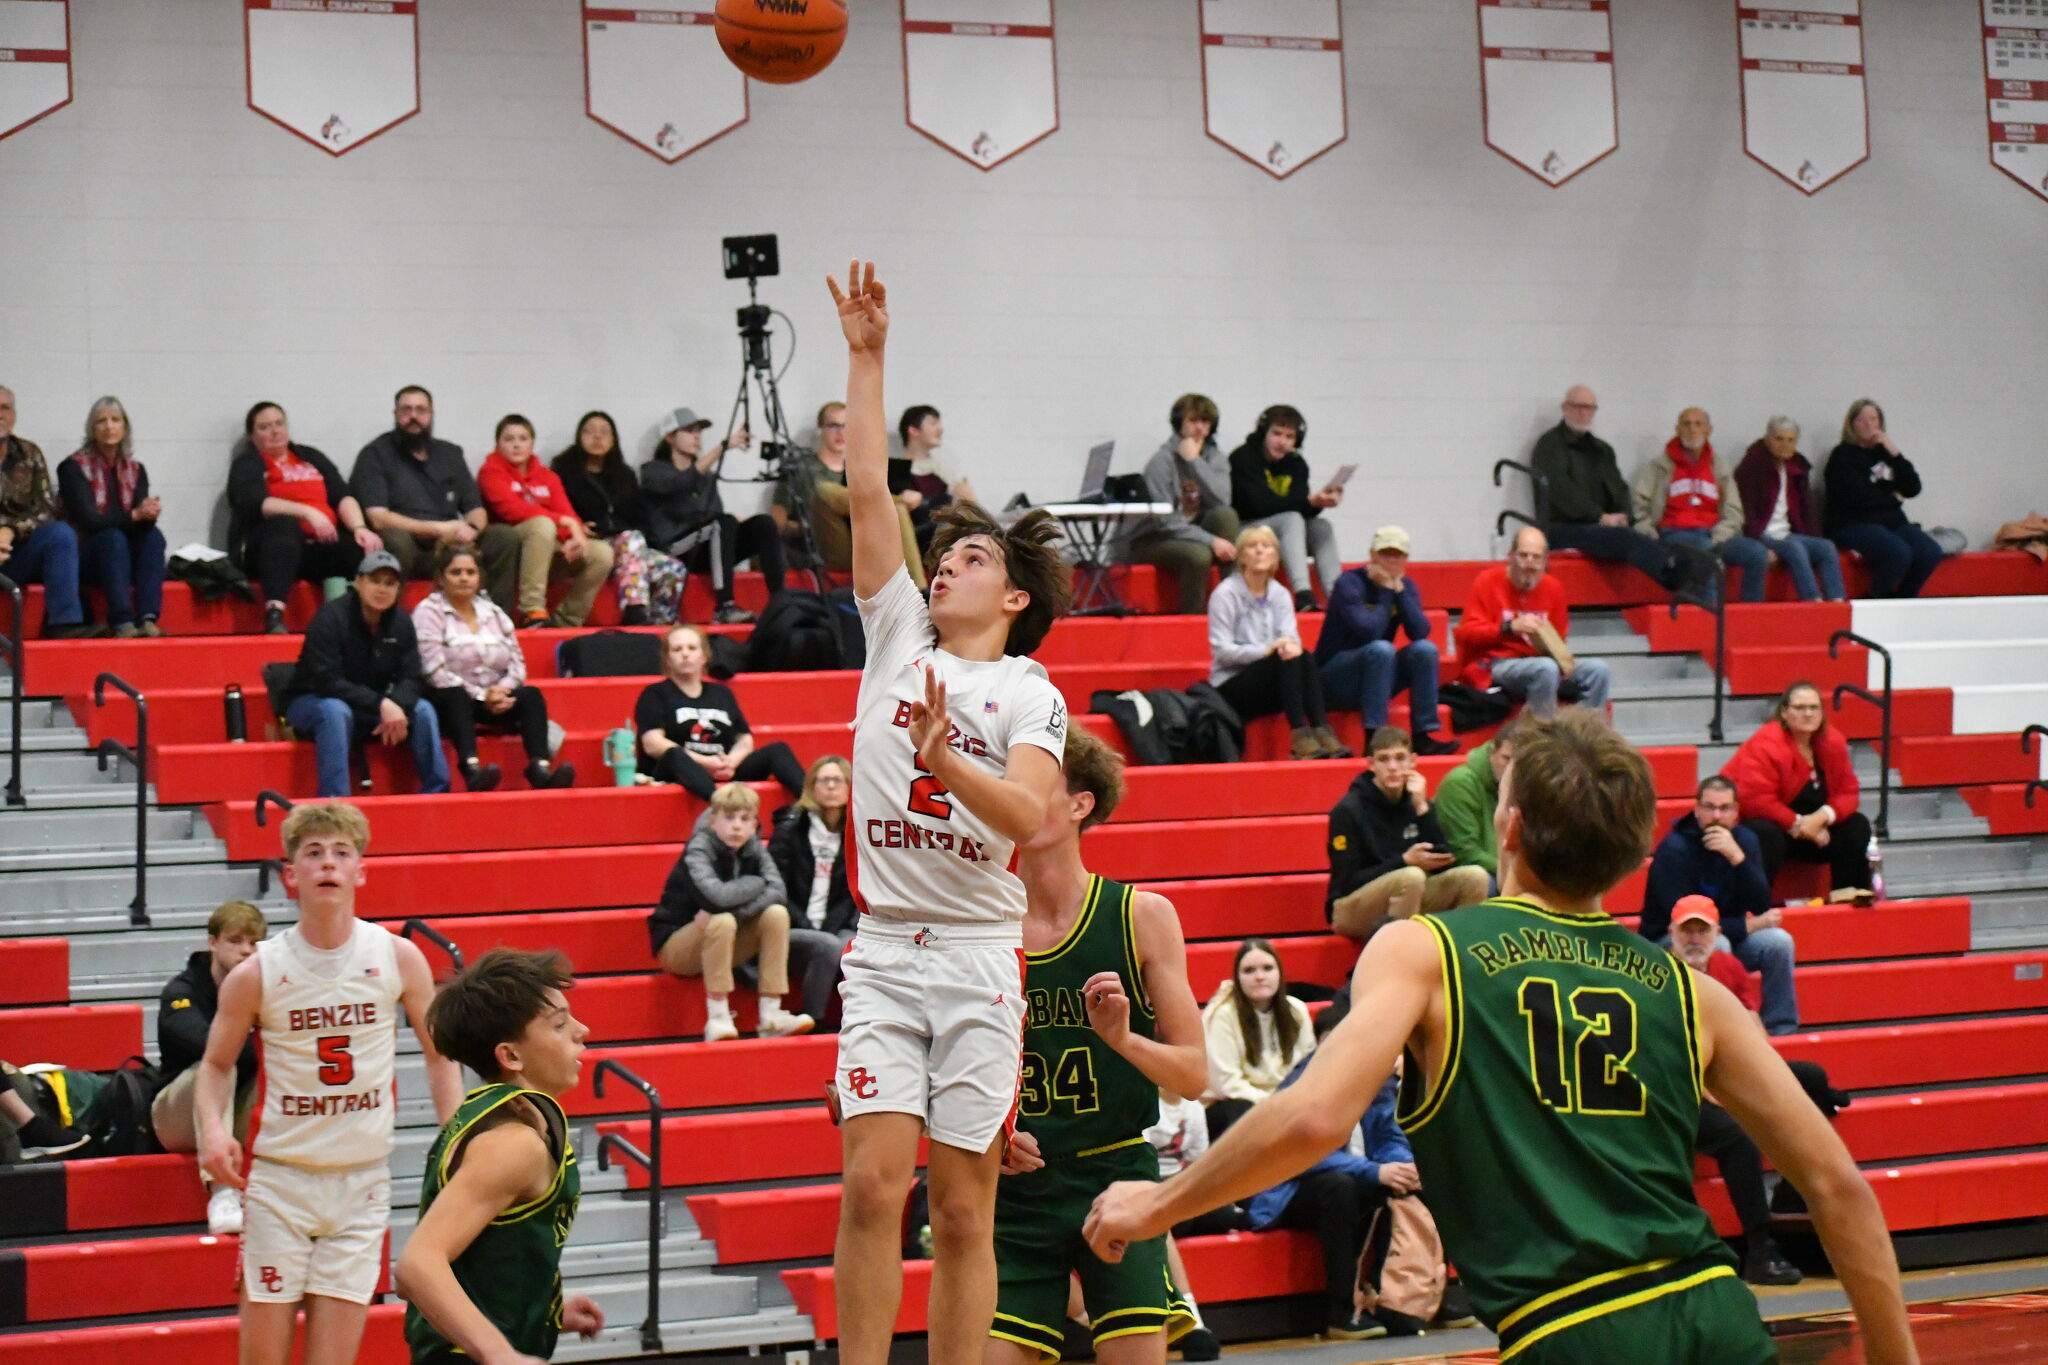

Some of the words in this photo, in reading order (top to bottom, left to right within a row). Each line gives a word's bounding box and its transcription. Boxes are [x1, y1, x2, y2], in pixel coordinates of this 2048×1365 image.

[892, 700, 987, 757] BZIE
[907, 752, 953, 820] 2
[1468, 927, 1670, 993] RAMBLERS
[289, 1003, 376, 1031] BENZIE
[1518, 977, 1647, 1115] 12
[317, 1035, 354, 1086] 5
[1019, 1047, 1099, 1116] 34
[282, 1089, 380, 1116] CENTRAL
